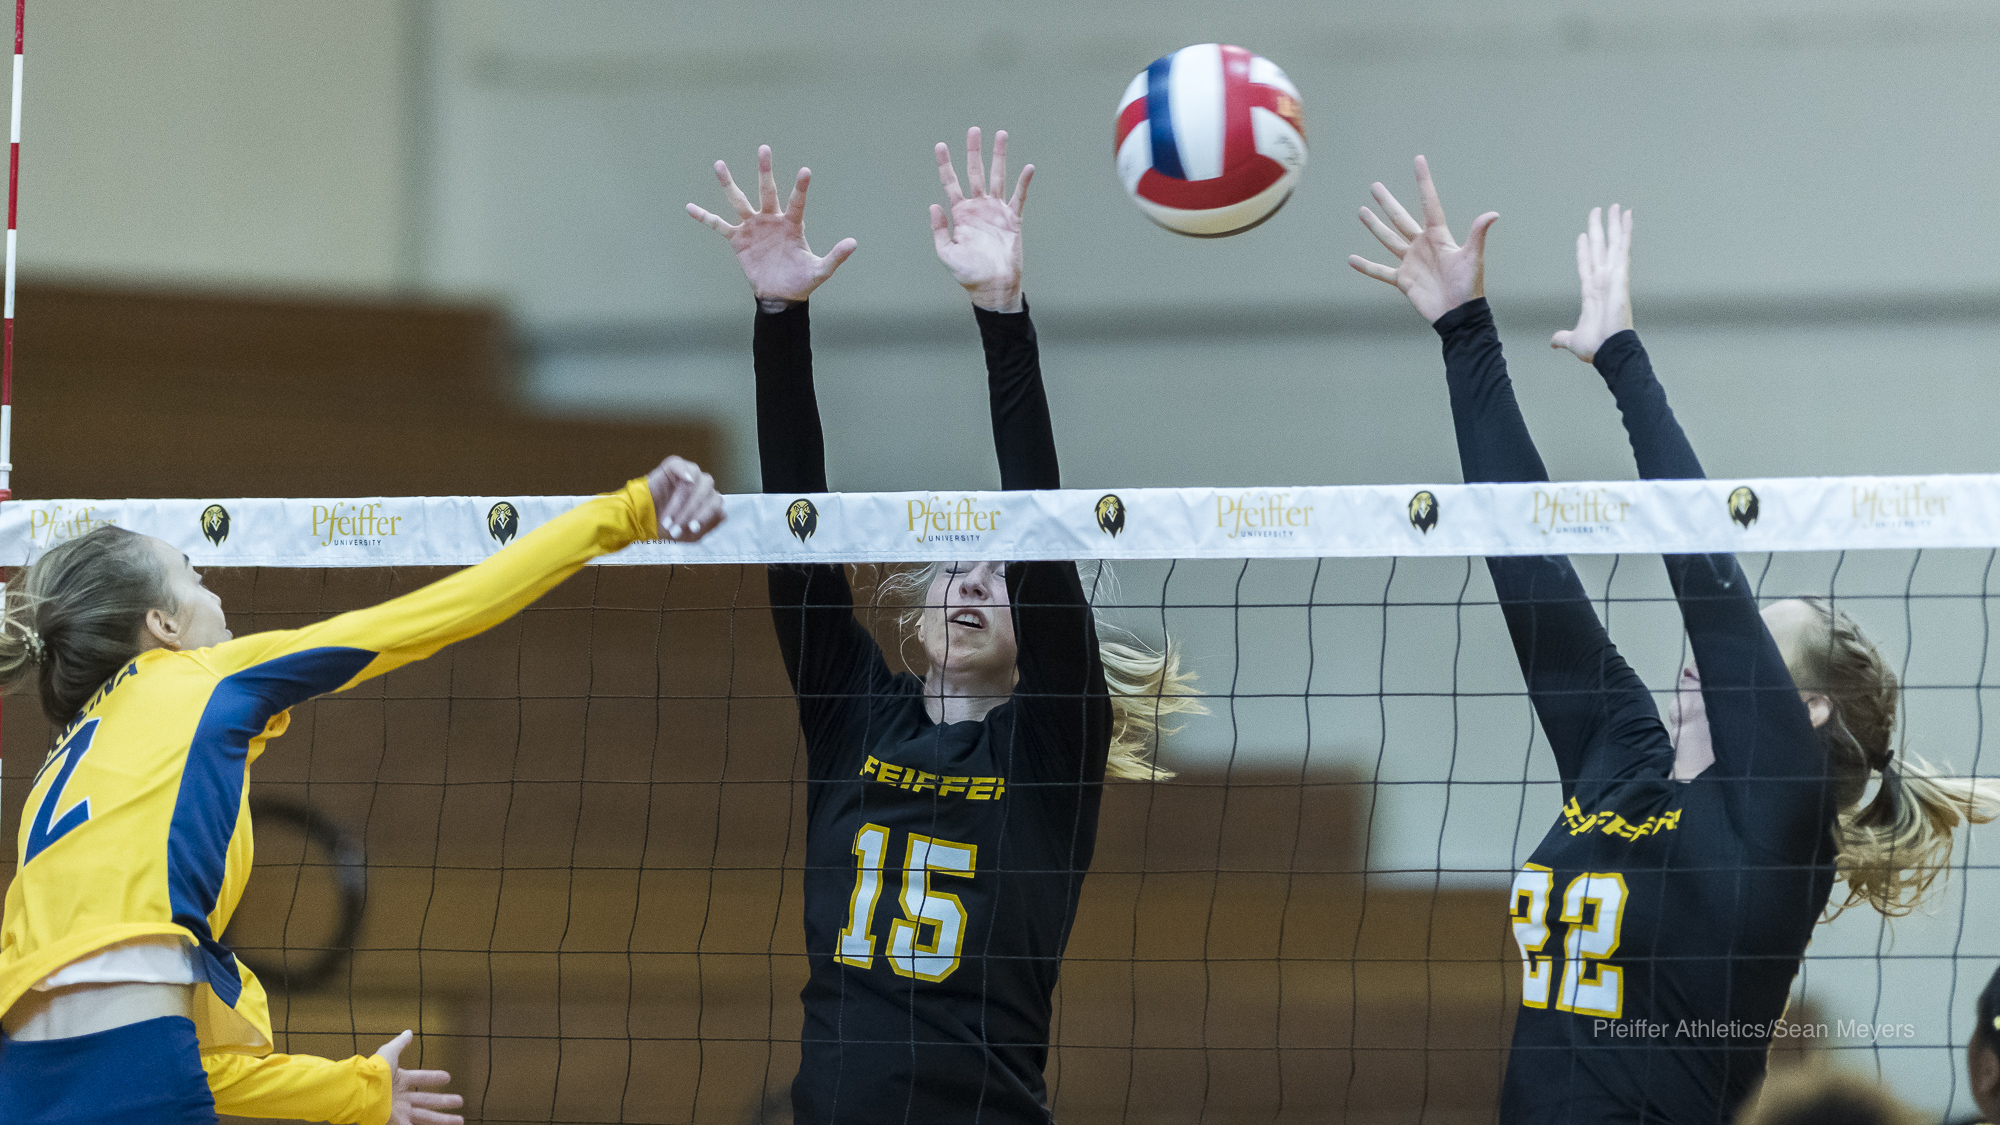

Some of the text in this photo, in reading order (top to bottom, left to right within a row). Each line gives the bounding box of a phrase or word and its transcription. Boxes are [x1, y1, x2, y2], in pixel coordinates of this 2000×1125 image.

[30, 505, 117, 549] Pfeiff
[310, 501, 402, 547] Pfeiffer
[906, 495, 1001, 543] Pfeiffer
[1215, 491, 1314, 539] Pfeiffer
[1240, 530, 1294, 538] UNIVERSITY
[1531, 487, 1630, 535] Pfeiffer
[928, 534, 980, 542] UNIVERSITY
[833, 822, 977, 983] 15
[1509, 862, 1630, 1020] 22
